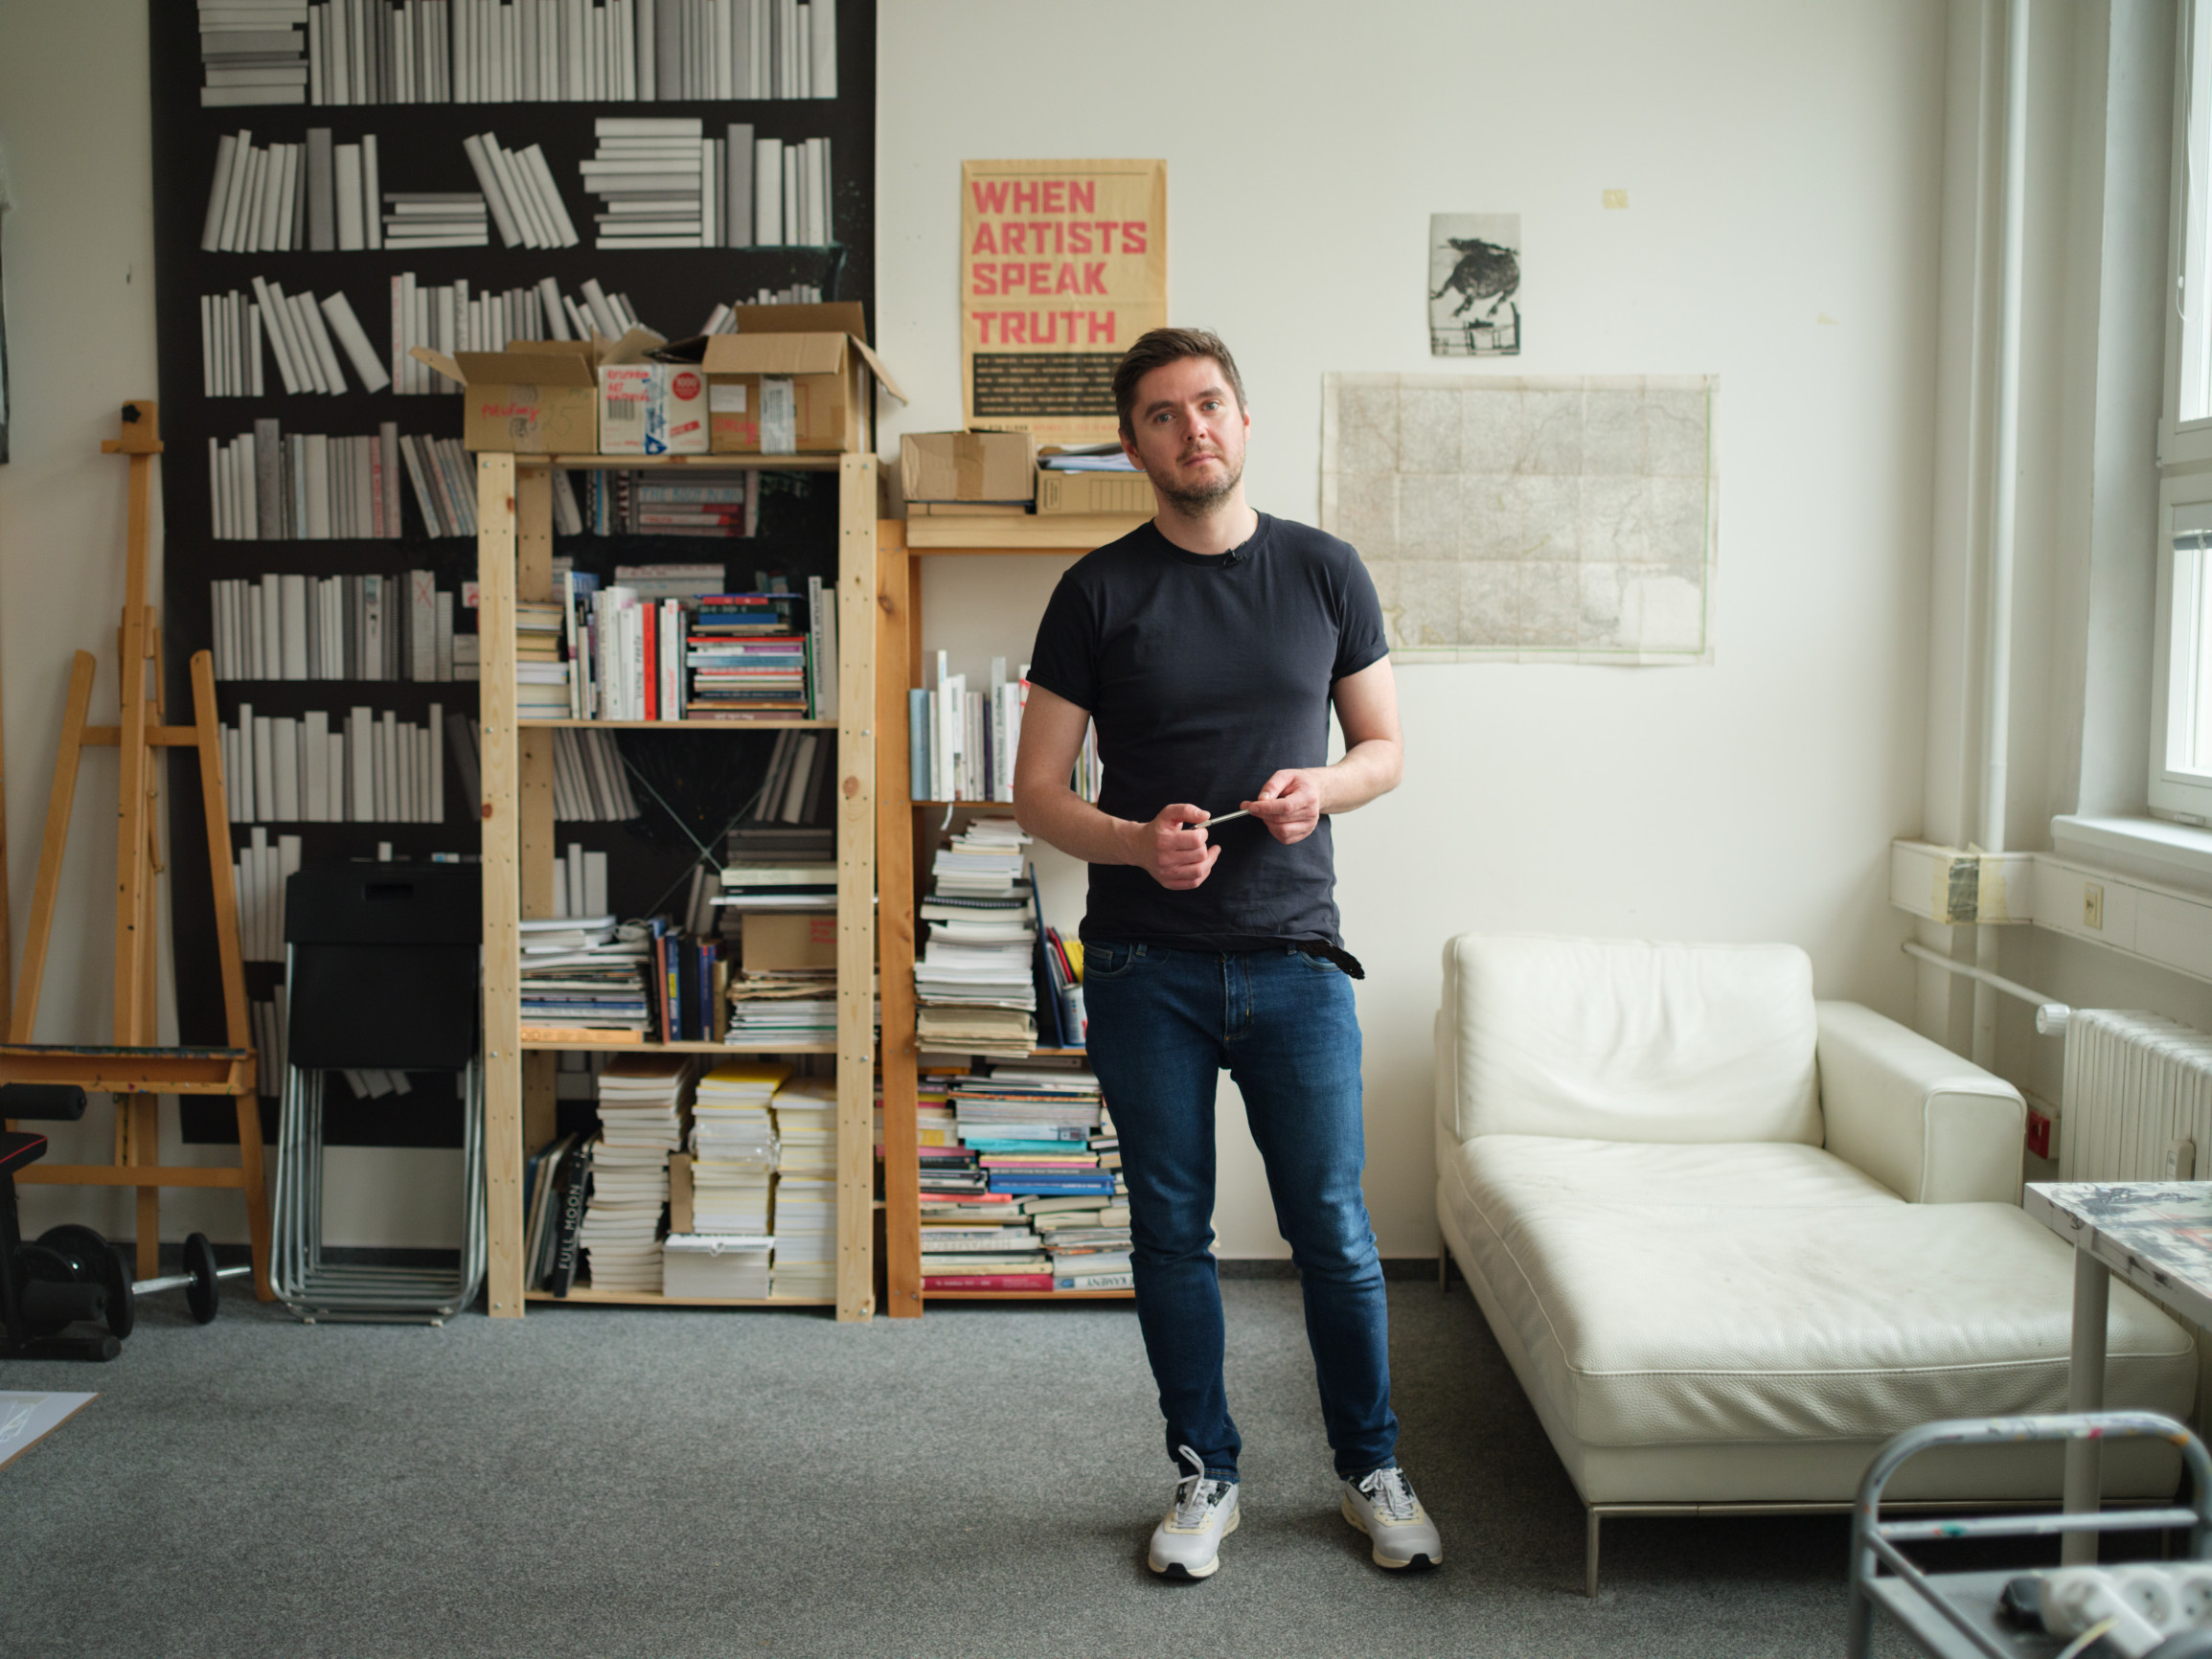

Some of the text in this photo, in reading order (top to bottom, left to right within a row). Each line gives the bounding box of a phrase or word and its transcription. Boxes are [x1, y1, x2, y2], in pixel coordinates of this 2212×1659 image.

[971, 181, 1095, 215] WHEN
[971, 221, 1147, 255] ARTISTS
[972, 262, 1108, 295] SPEAK
[971, 311, 1116, 344] TRUTH
[559, 1184, 582, 1270] FULL MOON
[1087, 1275, 1128, 1288] KAMENY
